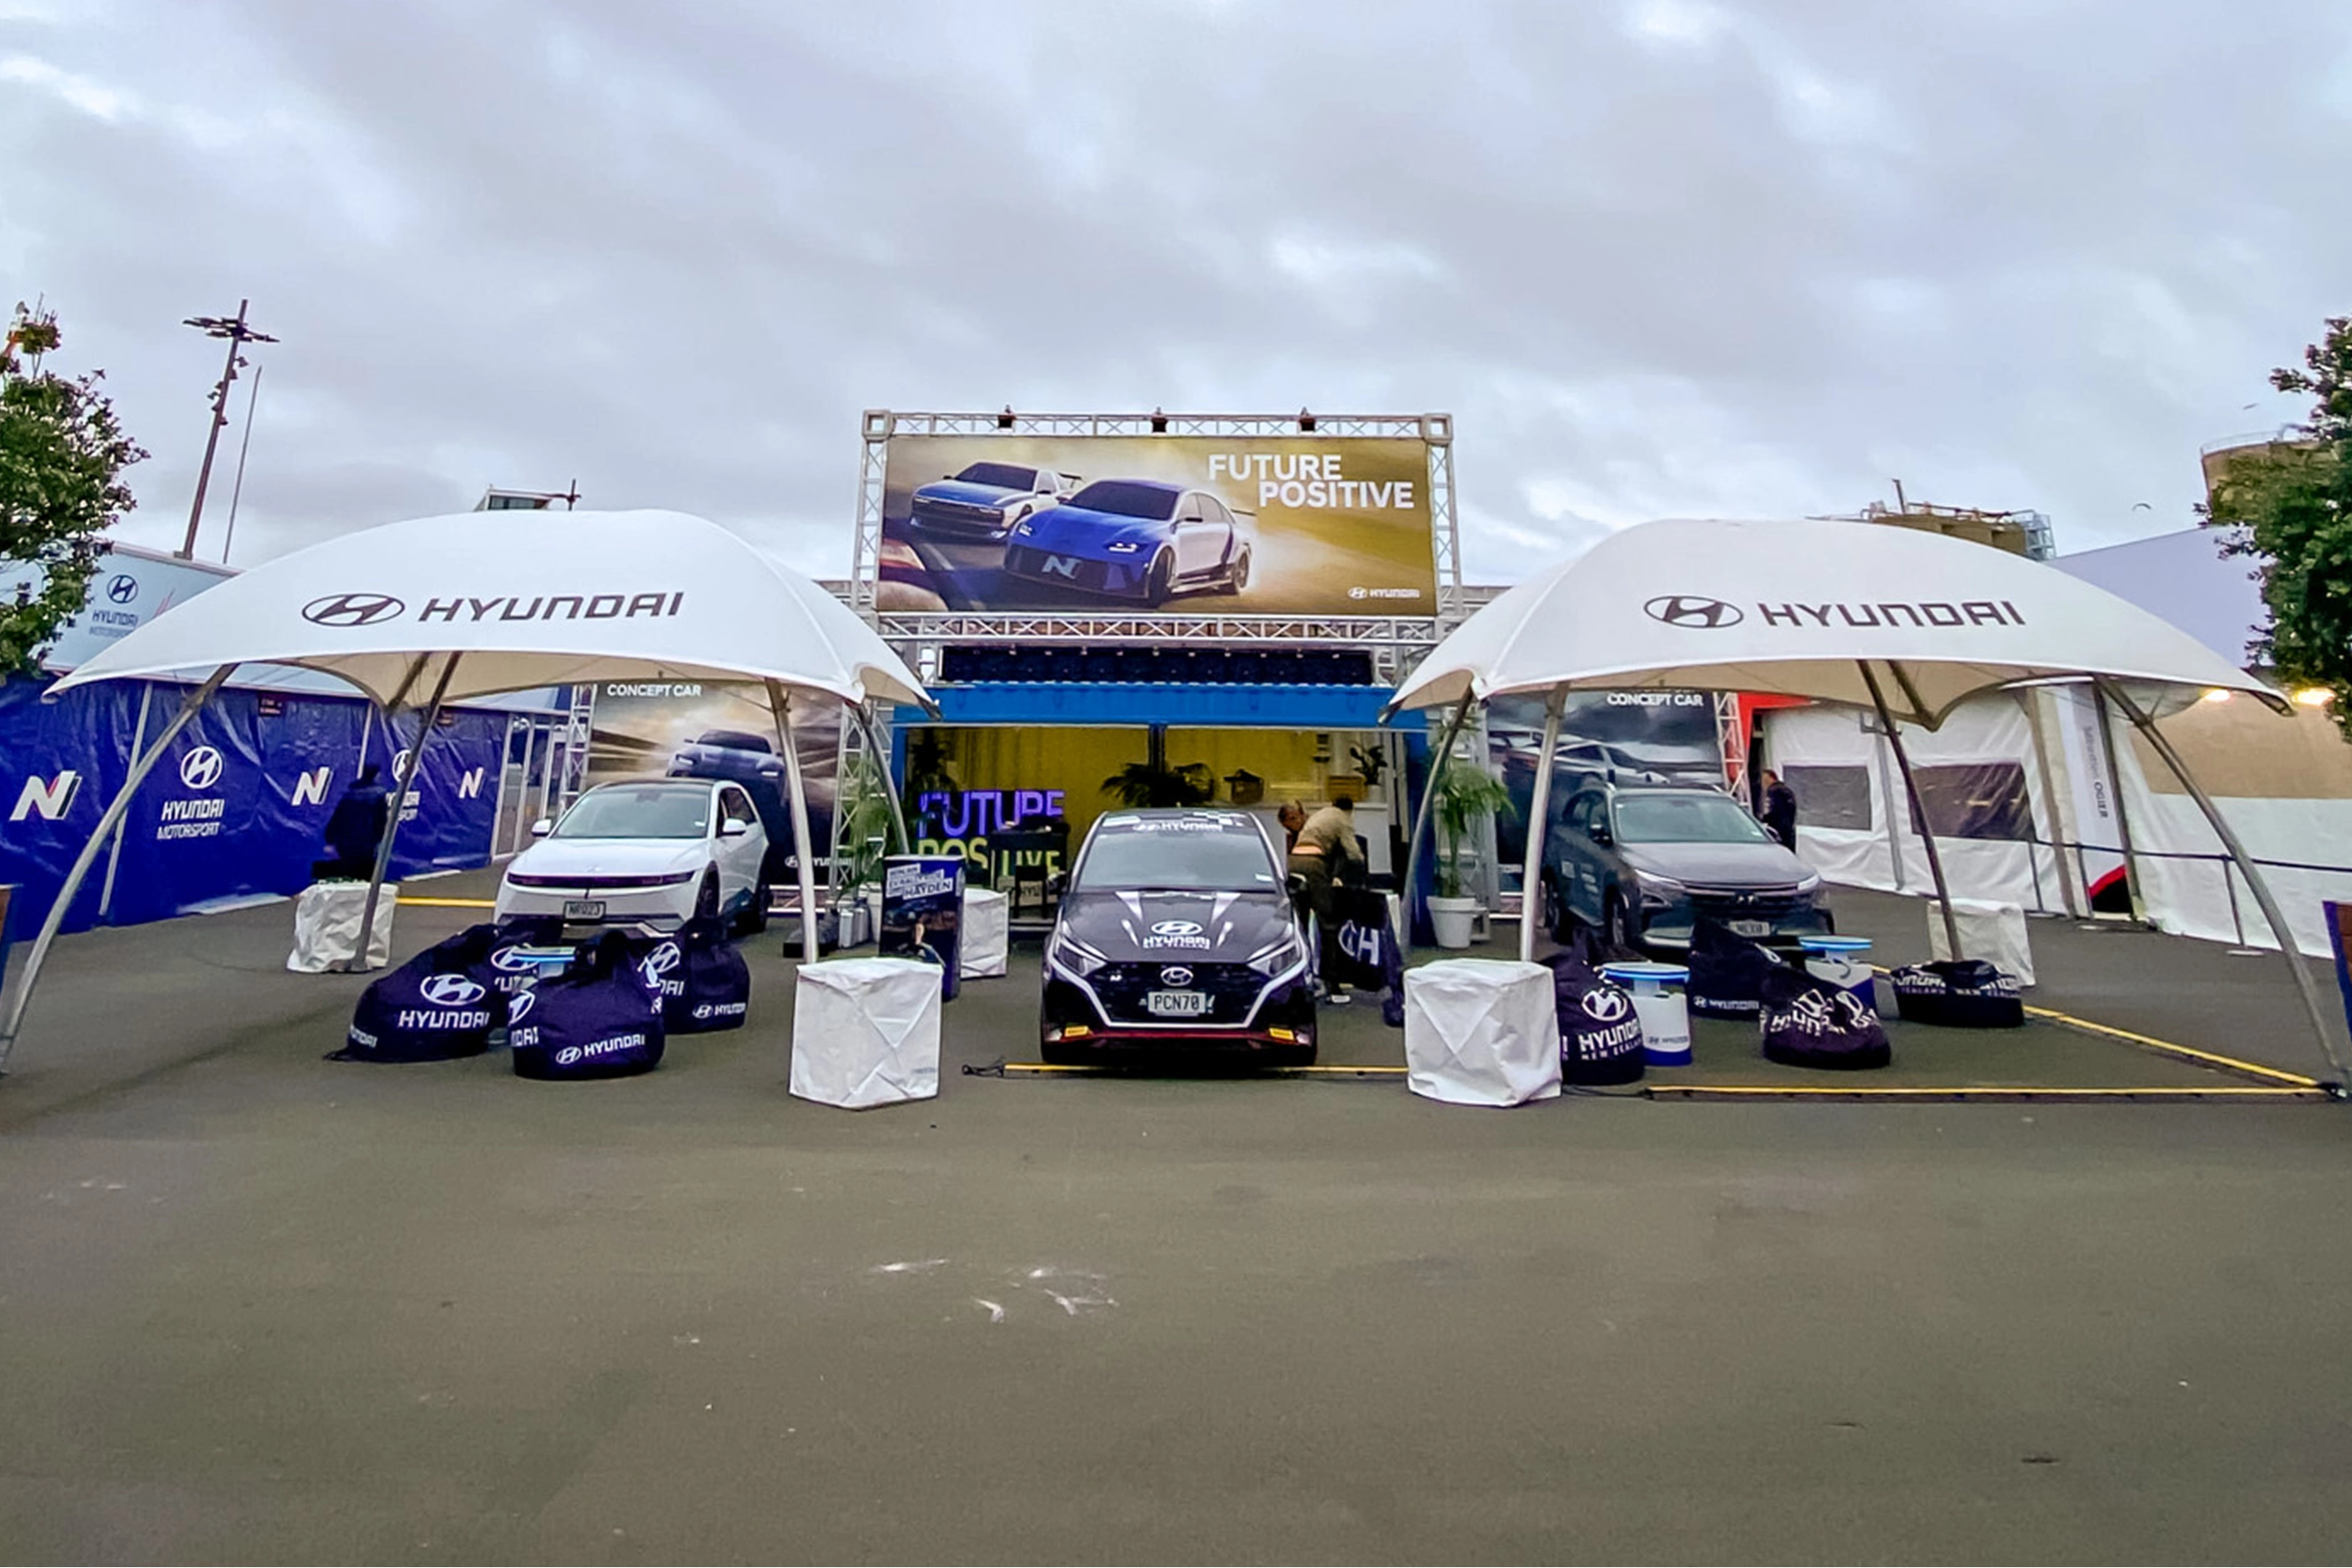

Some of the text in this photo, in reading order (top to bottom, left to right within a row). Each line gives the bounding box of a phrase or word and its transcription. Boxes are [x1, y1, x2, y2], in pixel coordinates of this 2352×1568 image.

[1209, 454, 1342, 481] FUTURE
[1259, 481, 1414, 508] POSITIVE
[1370, 588, 1420, 598] HYUNDAI
[418, 592, 684, 621] HYUNDAI
[1757, 600, 2026, 626] HYUNDAI
[607, 684, 702, 697] CONCEPT CAR
[1606, 693, 1704, 706] CONCEPT CAR
[292, 767, 333, 807] N
[459, 767, 484, 799] N
[9, 770, 82, 821] N
[2094, 781, 2108, 818] OGIER
[161, 799, 224, 821] HYUNDAI
[156, 822, 220, 840] MOTORSPORT
[1161, 822, 1222, 832] HYUNDAI
[905, 881, 951, 897] HAYDEN
[1143, 936, 1210, 947] HYUNDAI
[714, 1003, 746, 1016] HYUNDAI
[1709, 1000, 1760, 1010] HYUNDAI
[399, 1010, 490, 1029] HYUNDAI
[584, 1034, 645, 1056] HYUNDAI
[1578, 1018, 1643, 1052] HYUNDA
[1581, 1050, 1608, 1060] NEW
